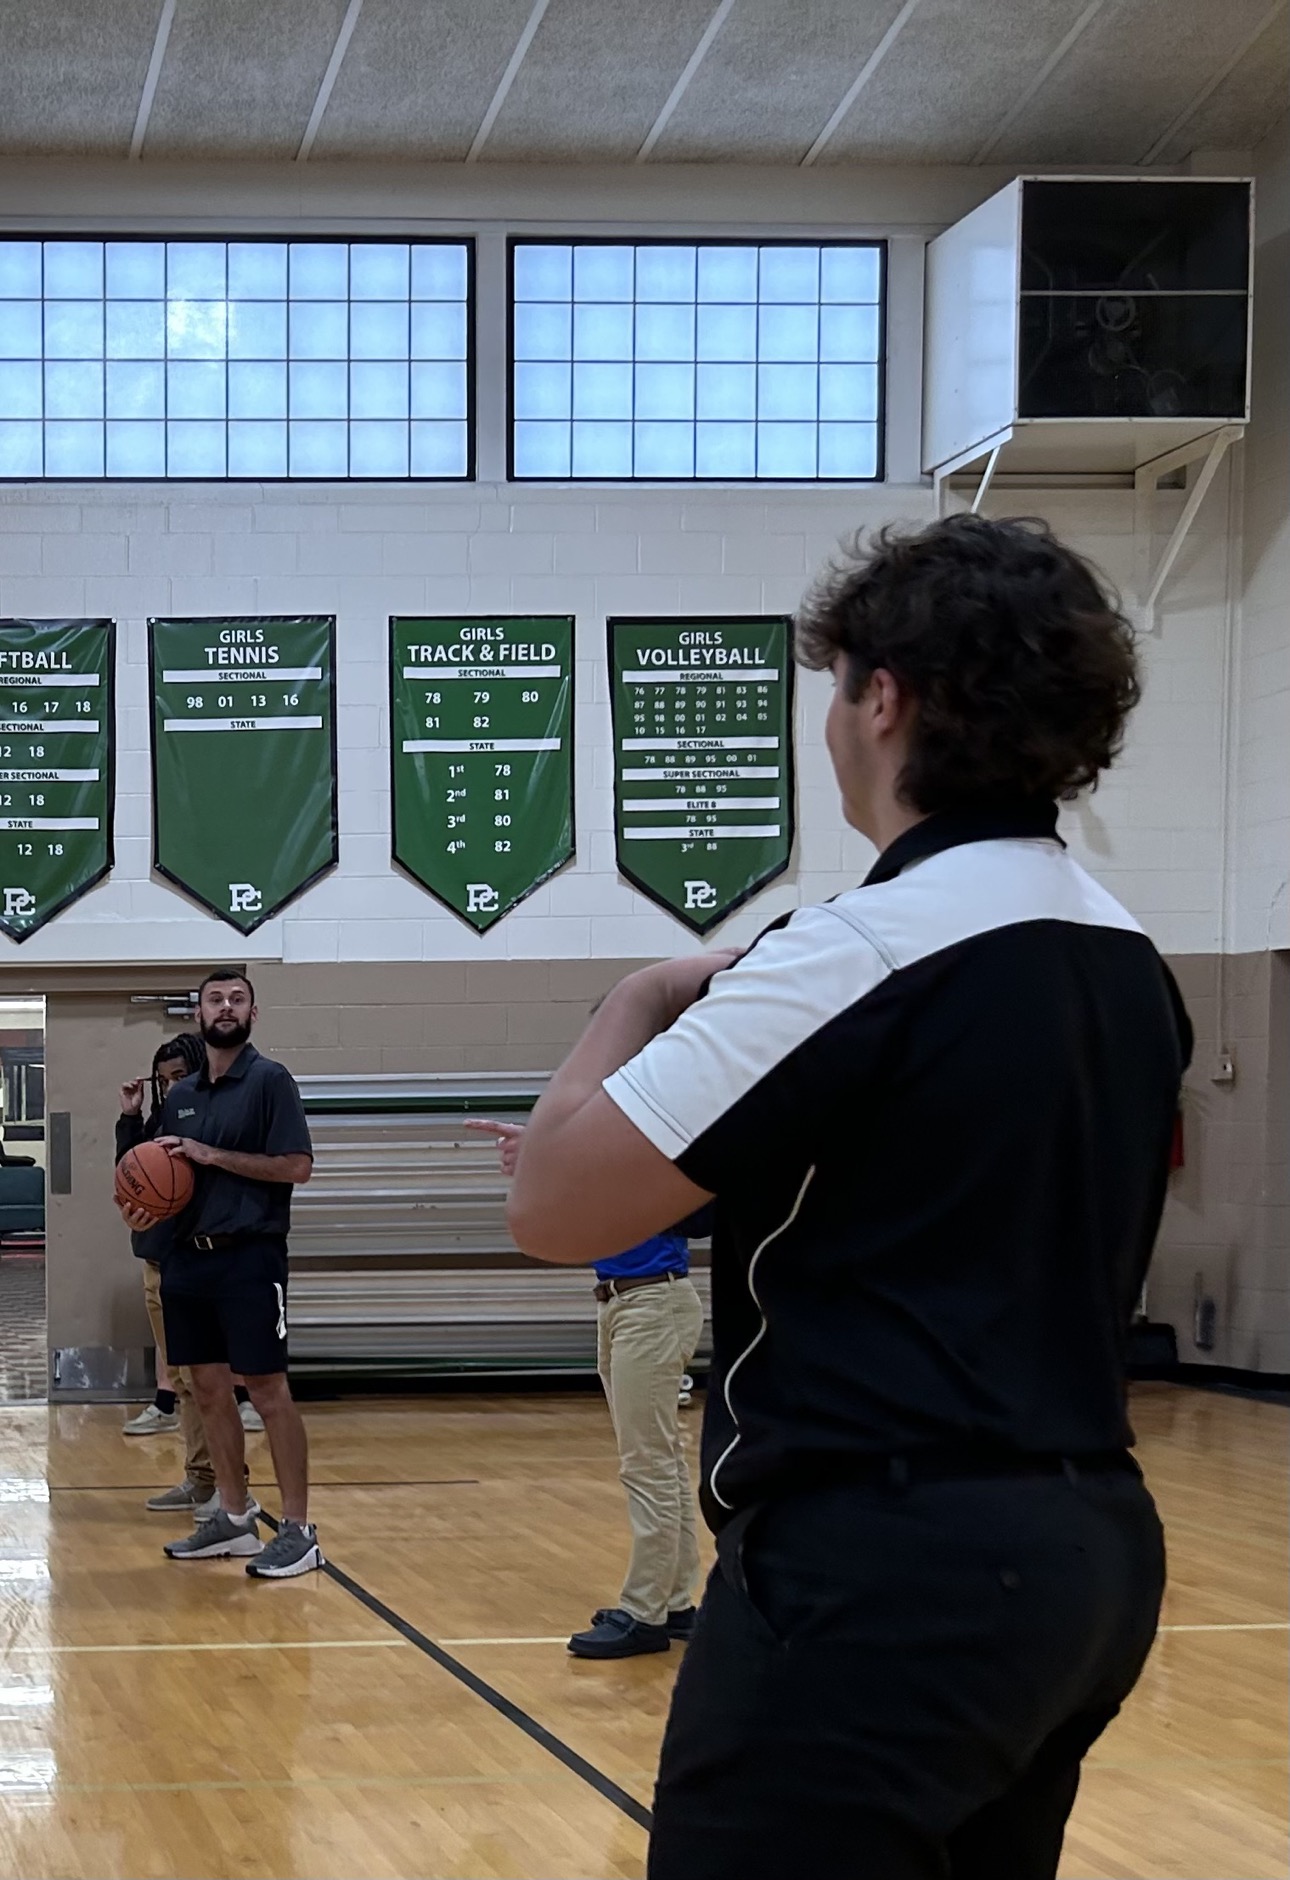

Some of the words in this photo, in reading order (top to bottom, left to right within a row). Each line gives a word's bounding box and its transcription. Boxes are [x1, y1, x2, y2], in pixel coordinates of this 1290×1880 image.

[220, 630, 263, 643] GIRLS
[460, 628, 504, 640] GIRLS
[679, 632, 722, 644] GIRLS
[0, 650, 72, 668] FTBALL
[205, 646, 279, 664] TENNIS
[408, 645, 474, 662] TRACK
[480, 644, 494, 661] &
[500, 644, 555, 660] FIELD
[637, 648, 765, 665] VOLLEYBALL
[219, 672, 266, 680] SECTIONAL
[697, 686, 706, 694] 79
[187, 697, 203, 708] 98
[218, 696, 232, 707] 01
[251, 696, 266, 706] 13
[283, 694, 298, 706] 16
[426, 693, 440, 704] 78
[474, 692, 489, 703] 79
[522, 692, 538, 702] 80
[736, 700, 746, 708] 93
[12, 702, 27, 712] 16
[44, 702, 58, 712] 17
[76, 701, 90, 712] 18
[426, 717, 439, 728] 81
[474, 717, 489, 728] 82
[634, 714, 644, 722] 95
[29, 746, 44, 757] 18
[748, 754, 756, 762] 01
[449, 765, 464, 778] 1st
[495, 765, 510, 776] 78
[29, 795, 44, 805] 18
[447, 789, 466, 802] 2nd
[495, 789, 508, 800] 81
[448, 814, 465, 828] 3rd
[495, 815, 510, 826] 80
[18, 844, 32, 855] 12
[48, 844, 63, 855] 18
[447, 840, 465, 854] 4th
[495, 841, 510, 852] 82
